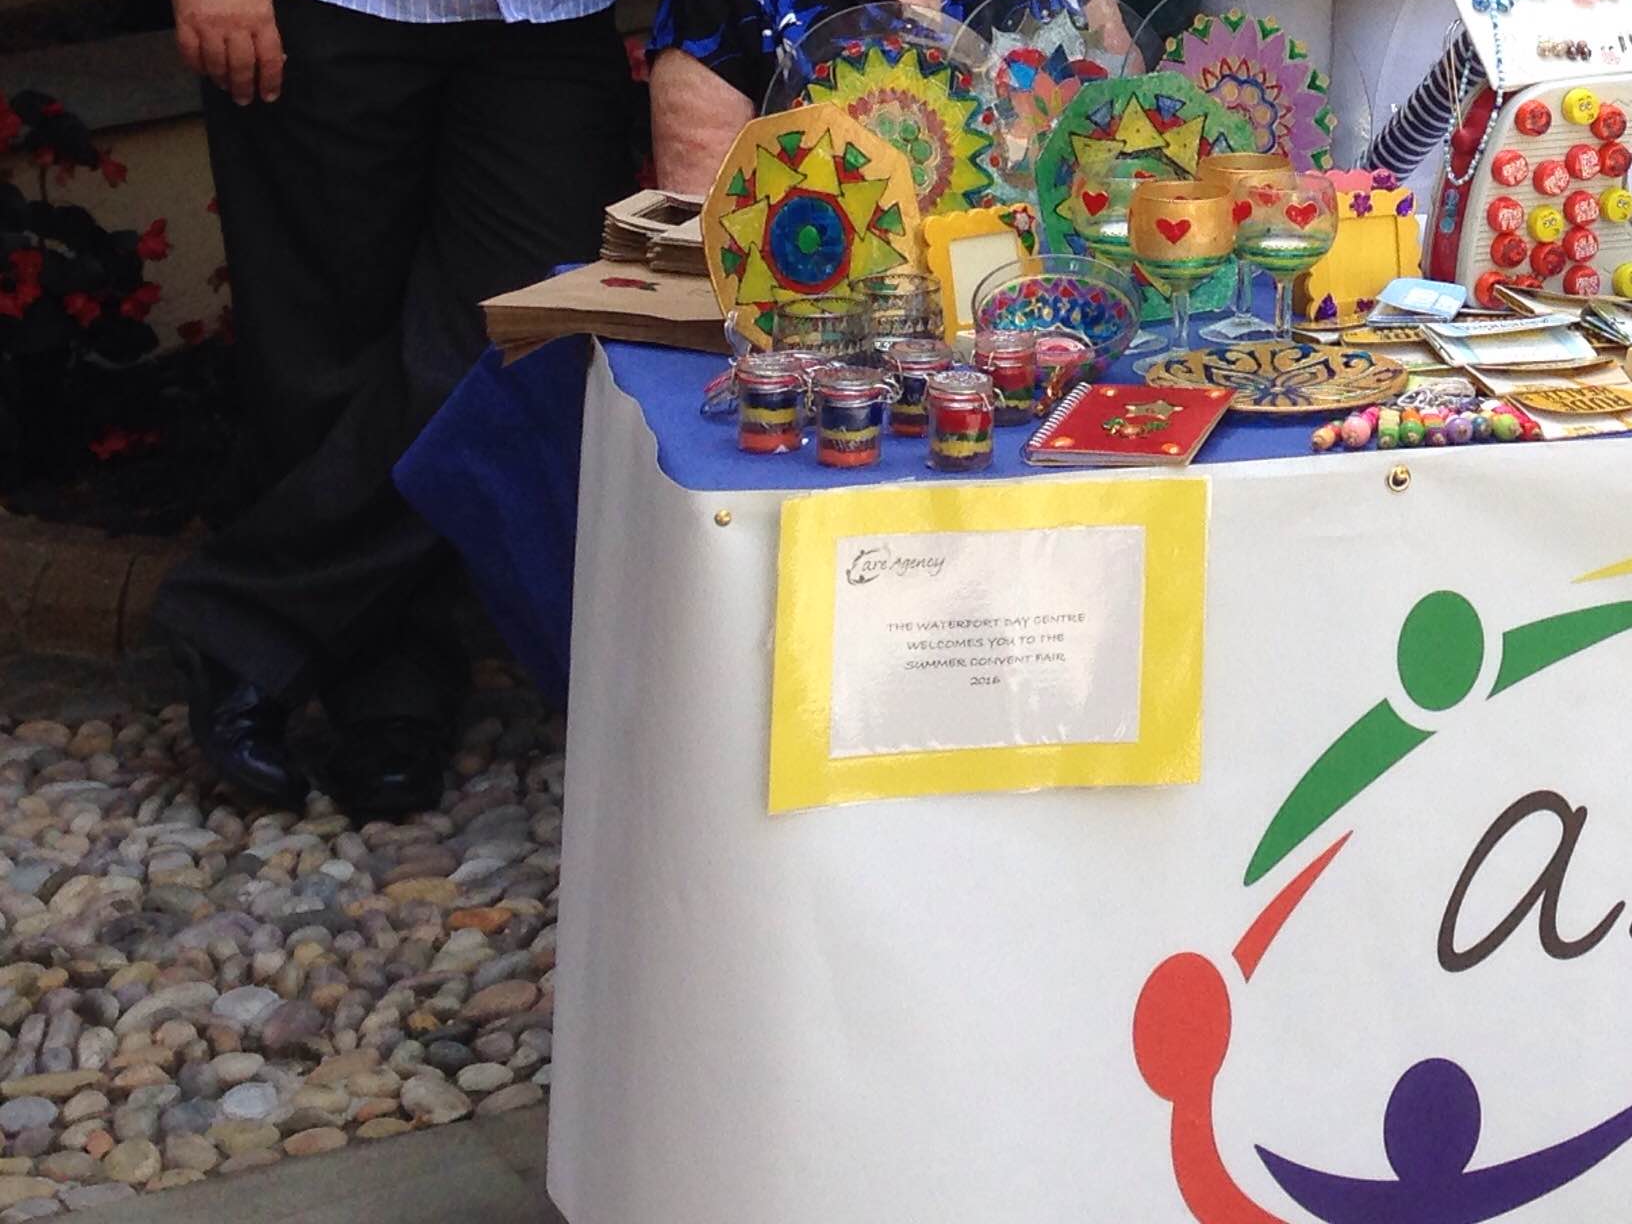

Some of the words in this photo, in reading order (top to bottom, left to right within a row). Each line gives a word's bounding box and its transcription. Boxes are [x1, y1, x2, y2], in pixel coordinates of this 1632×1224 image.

[888, 556, 945, 577] Agency
[887, 621, 913, 632] THE
[1003, 617, 1030, 629] DAY
[1033, 613, 1086, 625] CENTRE
[906, 638, 984, 651] WELCOMES
[988, 636, 1015, 648] YOU
[1019, 635, 1036, 645] TO
[1040, 633, 1065, 644] THE
[904, 658, 967, 671] SUMMER
[969, 654, 1033, 667] CONVENT
[1035, 652, 1067, 663] FAIR
